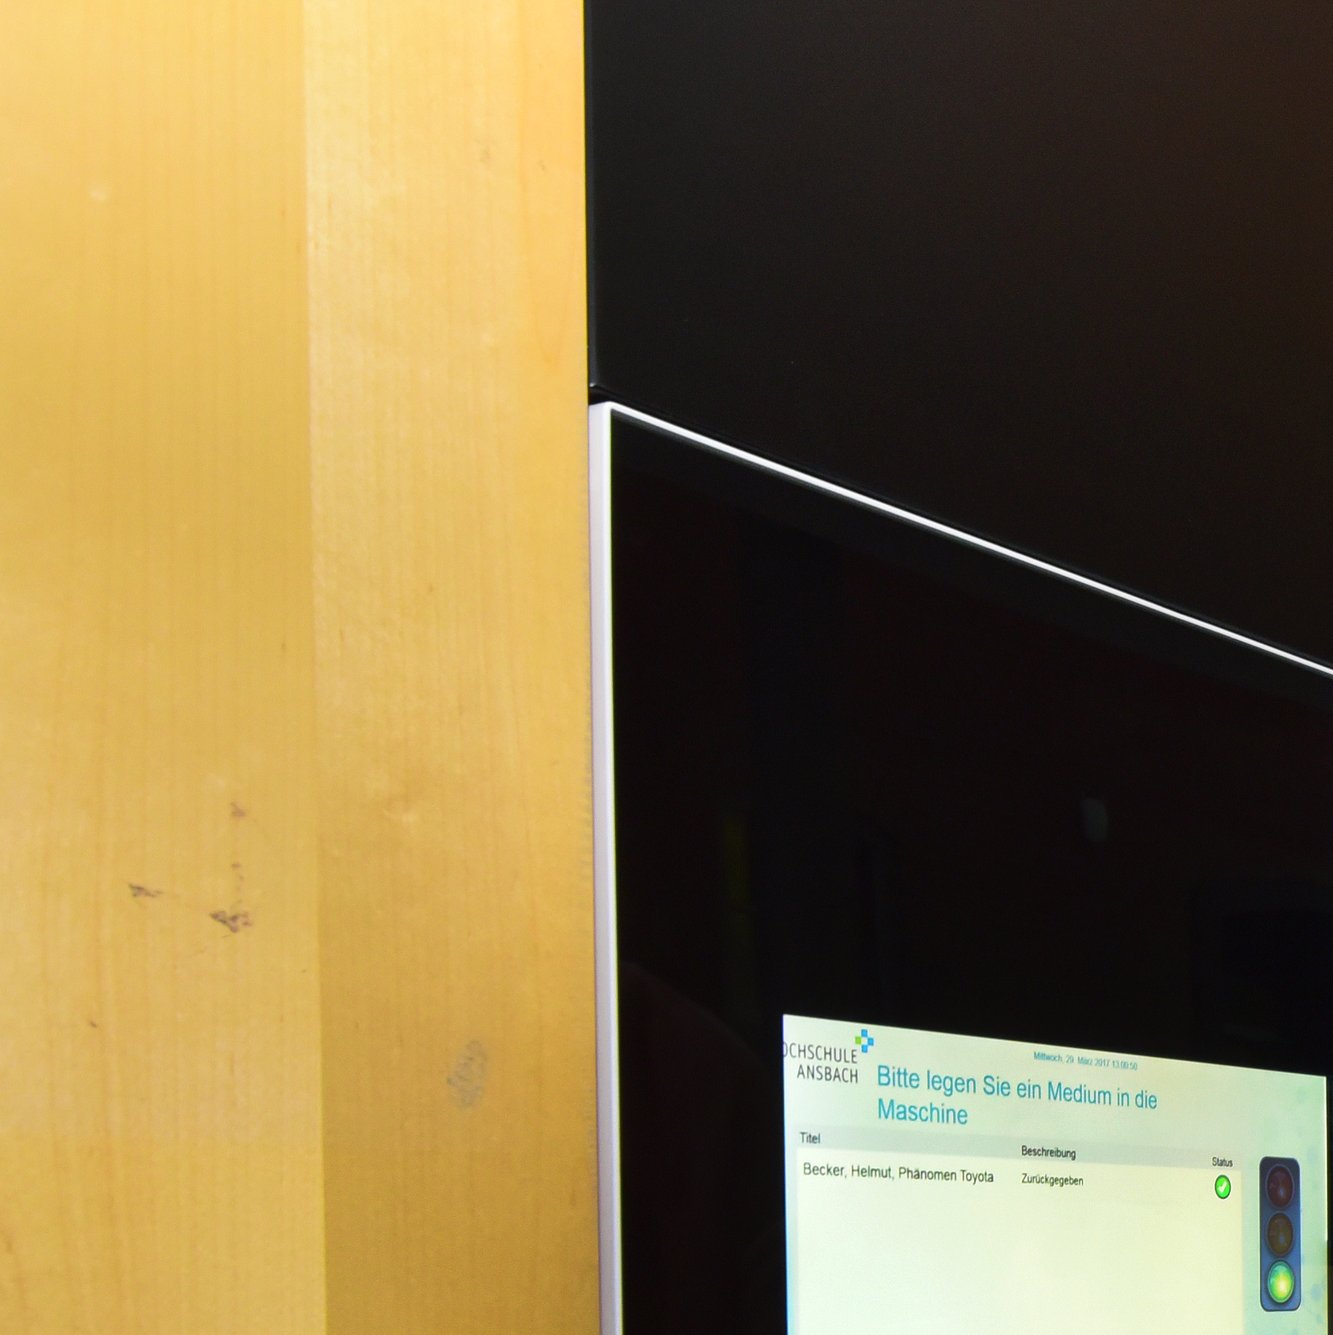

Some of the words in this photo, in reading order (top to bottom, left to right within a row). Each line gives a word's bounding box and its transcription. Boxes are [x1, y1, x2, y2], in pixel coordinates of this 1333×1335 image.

[797, 1064, 859, 1084] ANSBACH
[877, 1064, 920, 1089] Bitte
[926, 1069, 977, 1097] legen
[983, 1075, 1011, 1097] Sie
[1016, 1078, 1042, 1100] ein
[1048, 1081, 1112, 1106] Medium
[1117, 1087, 1130, 1107] in
[1135, 1089, 1158, 1110] die
[877, 1098, 968, 1125] Maschine
[800, 1131, 821, 1144] Titel
[1021, 1145, 1077, 1161] Beschreibung
[1212, 1156, 1234, 1169] Status
[803, 1161, 848, 1179] Becker,
[851, 1164, 895, 1181] Helmut,
[899, 1166, 957, 1182] Phänomen
[960, 1169, 995, 1185] Toyota
[1021, 1172, 1084, 1188] Zurückgegeben
